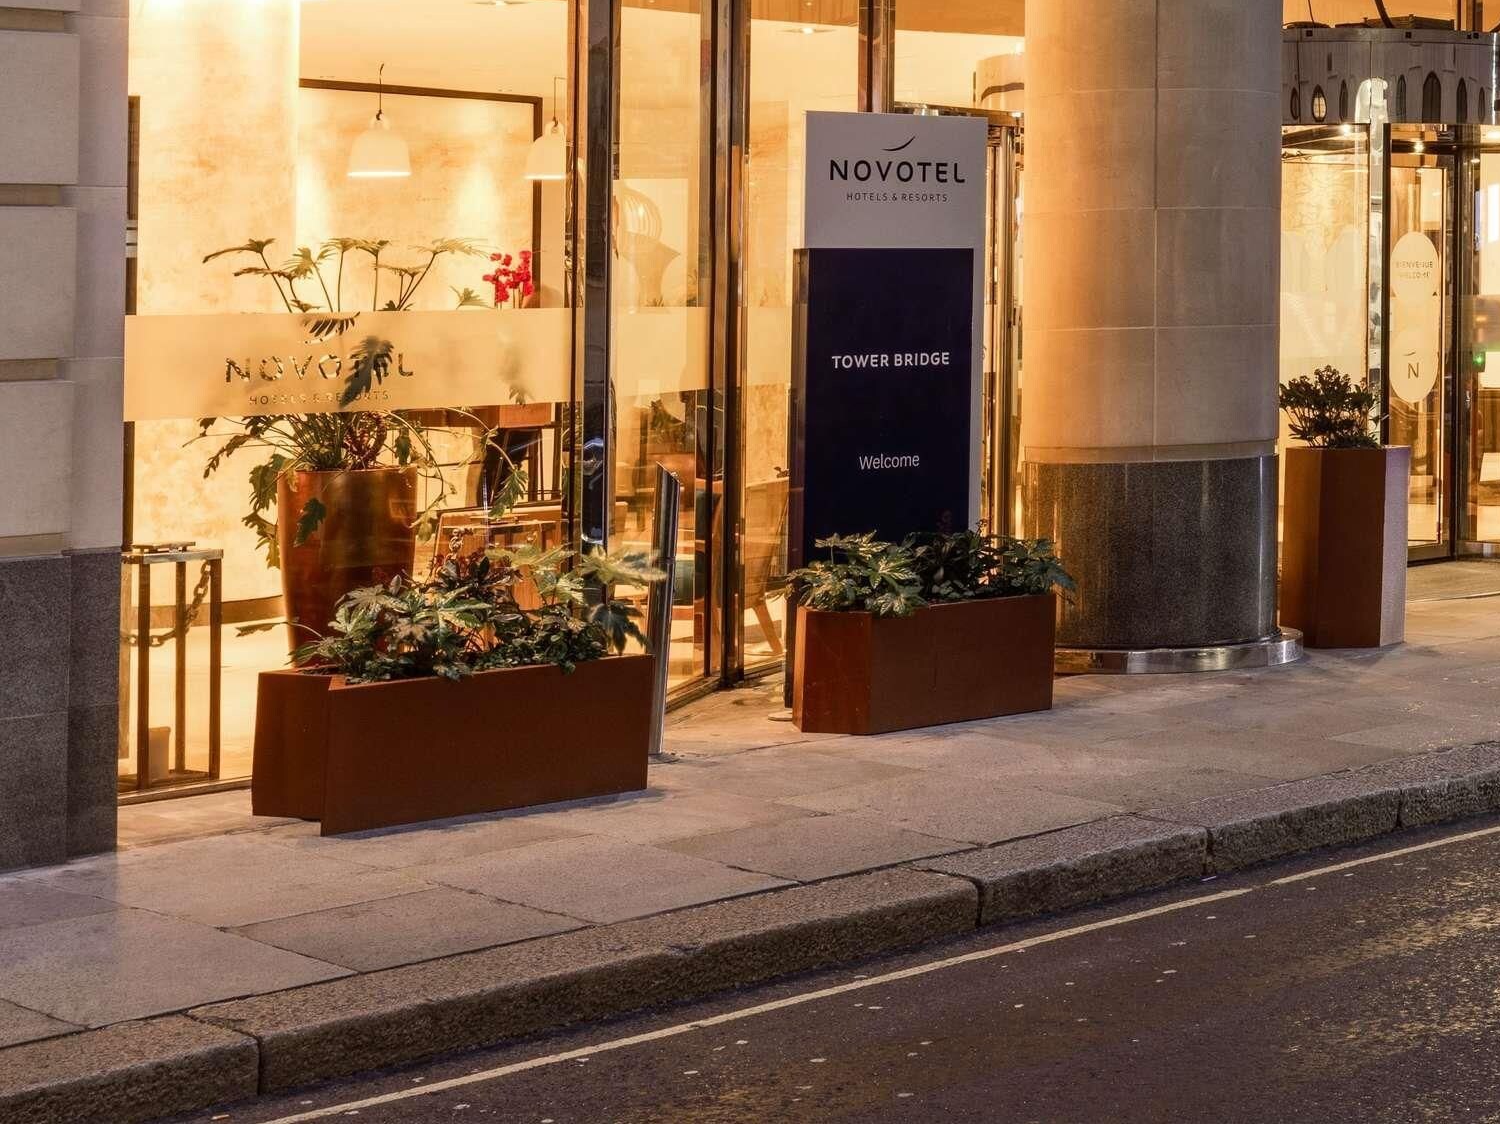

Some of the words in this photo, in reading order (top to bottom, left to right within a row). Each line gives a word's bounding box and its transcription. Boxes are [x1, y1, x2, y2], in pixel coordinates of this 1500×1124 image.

[829, 159, 966, 183] NOVOTEL
[847, 192, 888, 201] HOTELS
[891, 192, 898, 201] &
[901, 192, 948, 202] RESORTS
[225, 353, 414, 383] NOVOL
[832, 354, 889, 369] TOWER
[894, 352, 950, 367] BRIDGE
[1407, 362, 1419, 379] N
[859, 454, 920, 470] Welcome
